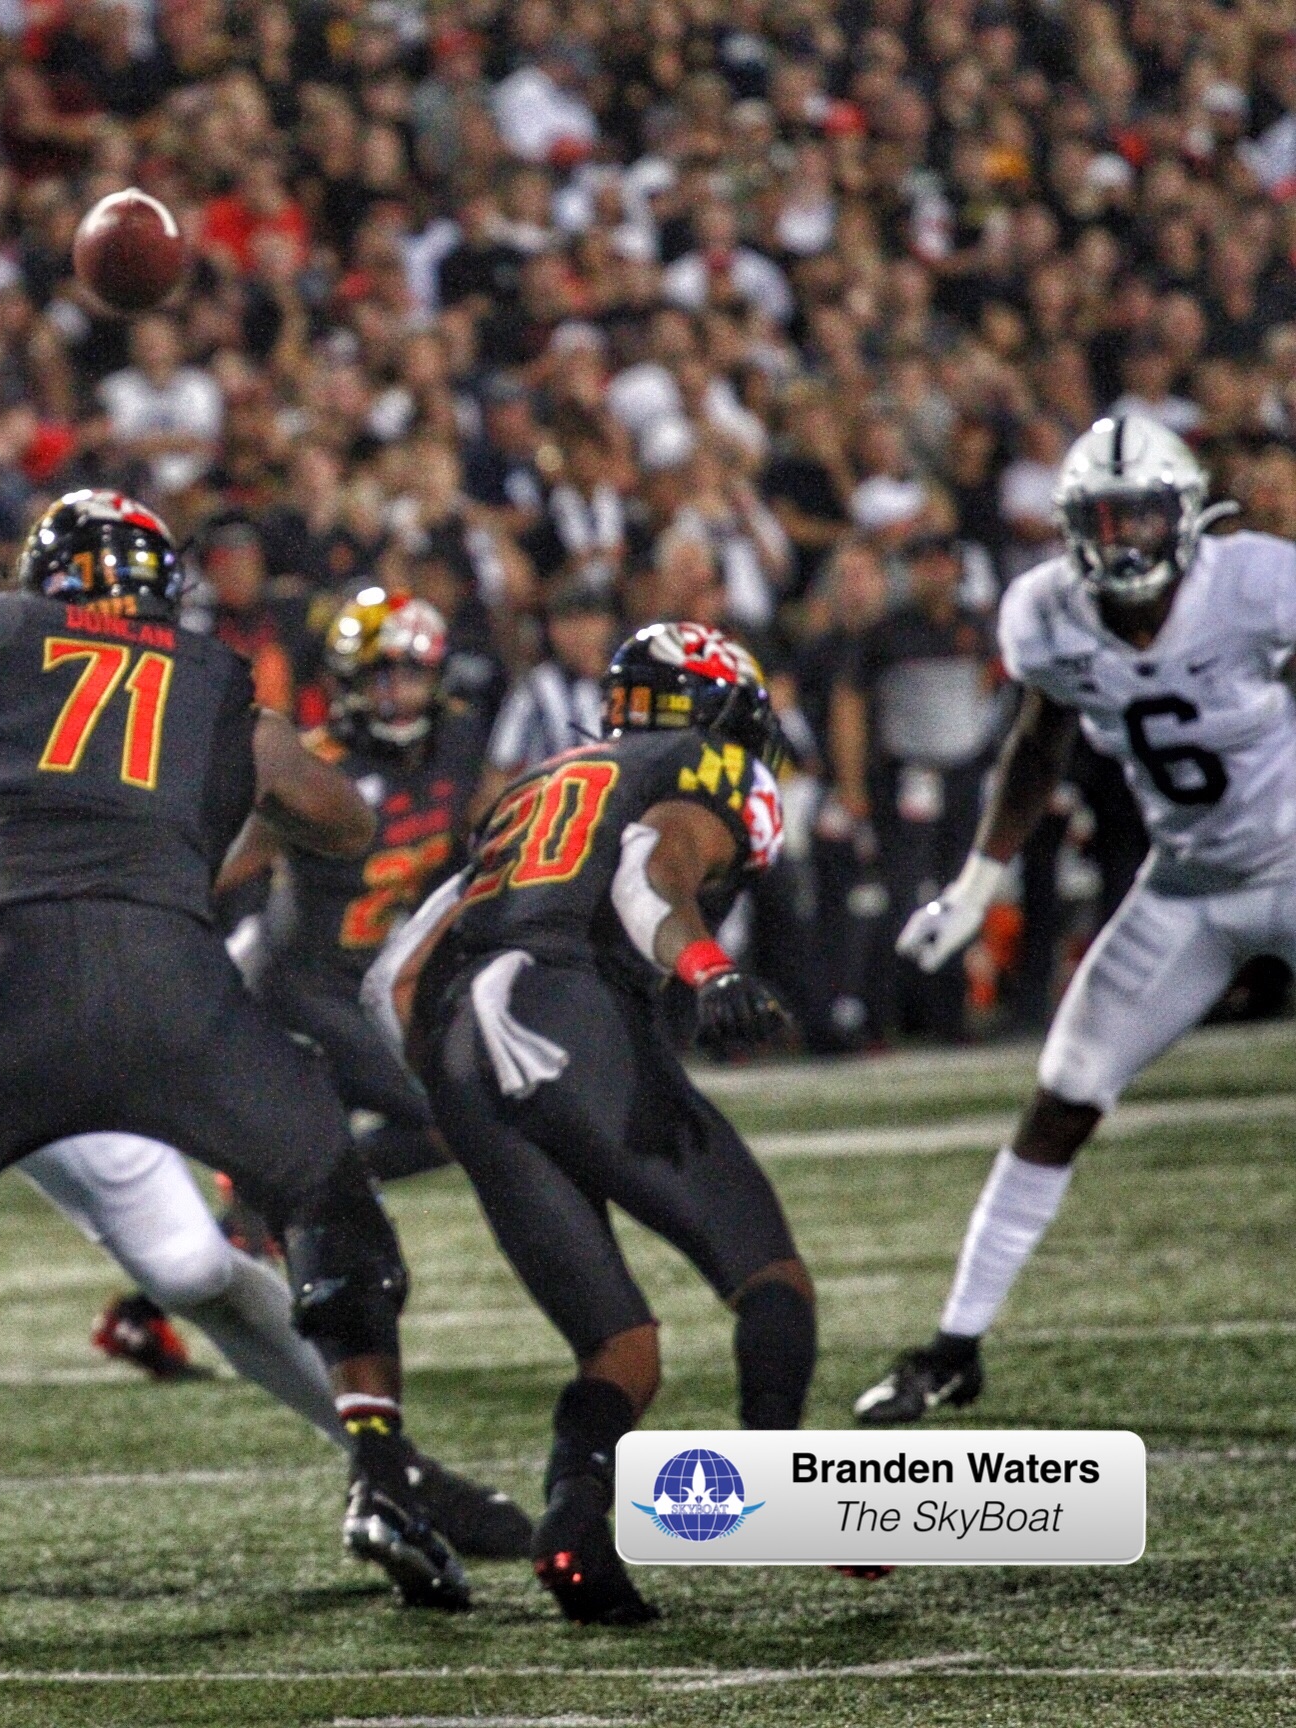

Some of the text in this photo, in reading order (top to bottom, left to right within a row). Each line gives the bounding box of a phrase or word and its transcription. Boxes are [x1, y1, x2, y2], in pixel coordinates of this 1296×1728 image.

[38, 637, 174, 791] 71
[1124, 692, 1230, 804] 6
[461, 761, 620, 905] 20
